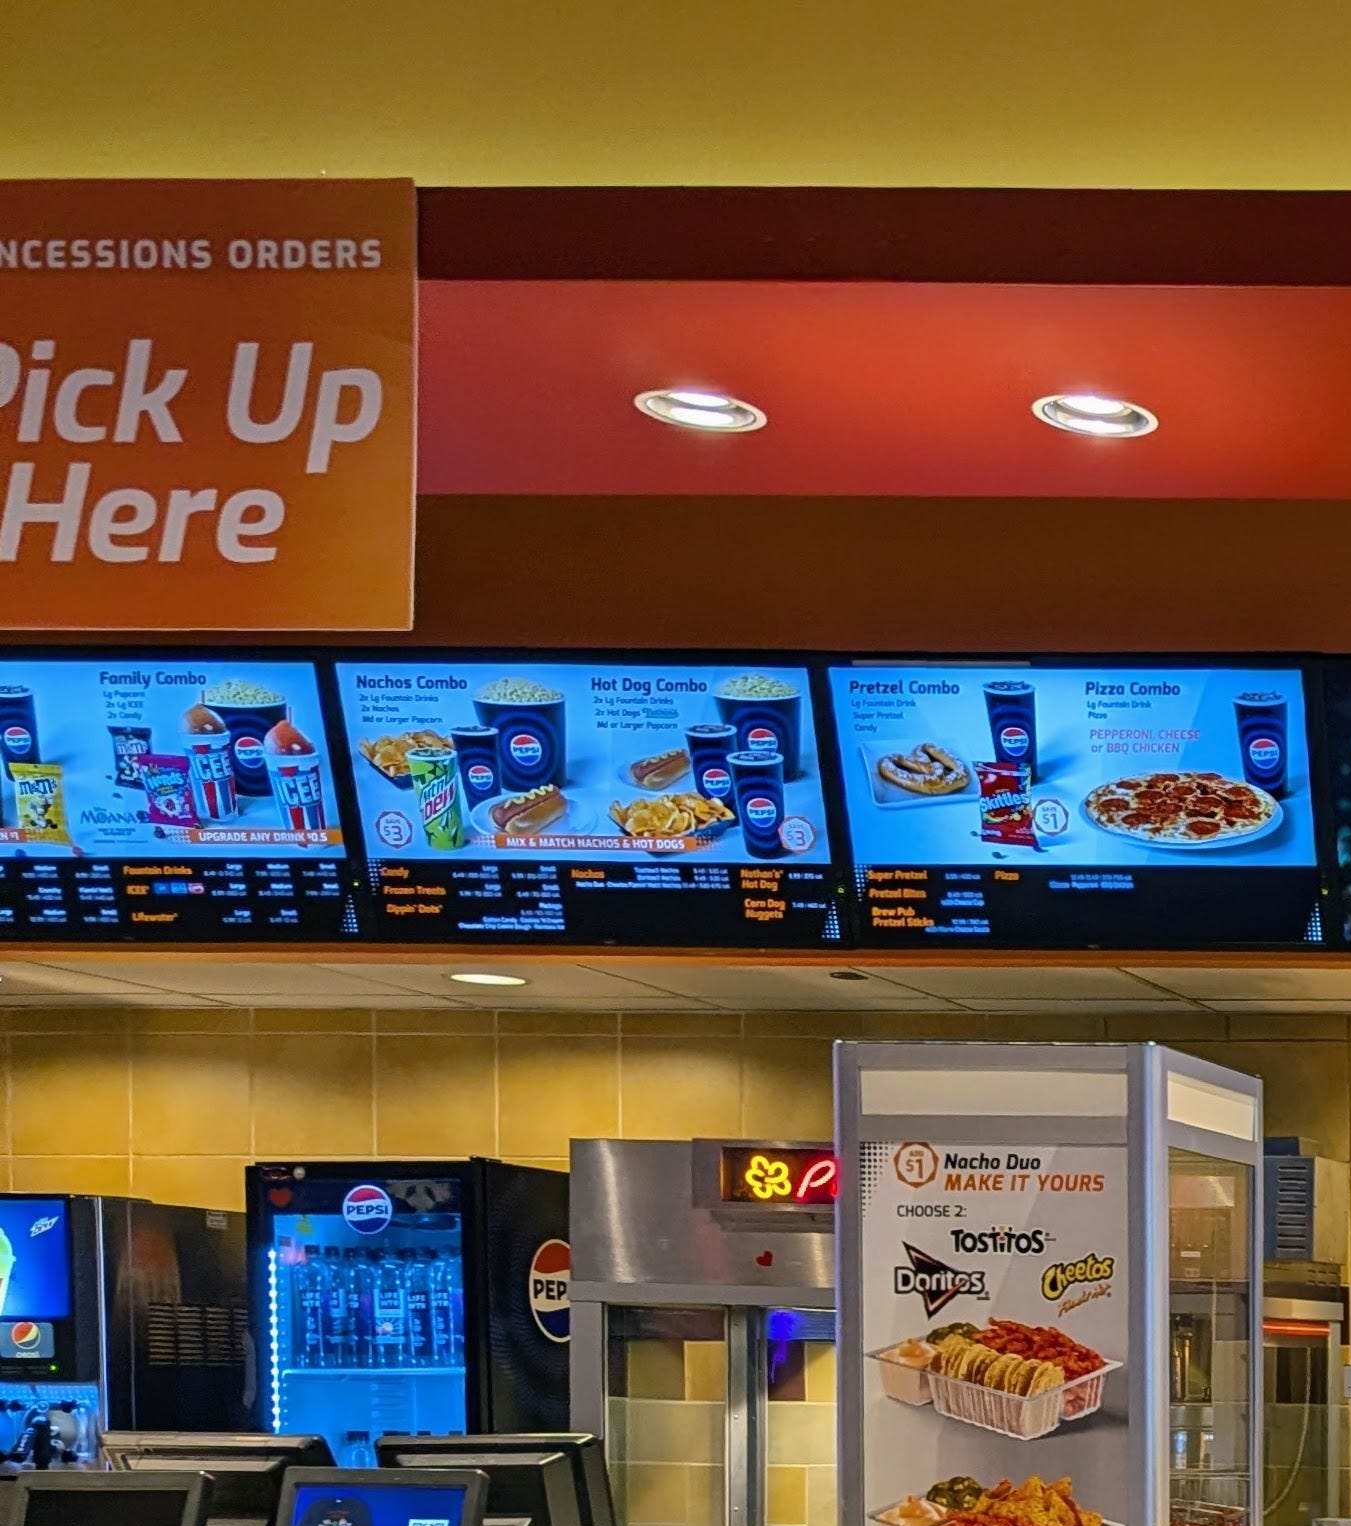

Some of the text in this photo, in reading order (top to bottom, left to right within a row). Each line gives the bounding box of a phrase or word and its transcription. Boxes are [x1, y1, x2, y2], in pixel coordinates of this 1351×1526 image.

[228, 239, 381, 269] ORDERS
[227, 342, 382, 474] Up
[0, 463, 285, 562] Here
[100, 671, 206, 689] Family Combo
[356, 675, 467, 690] Nachos Combo
[592, 677, 707, 695] Hot Dog Combo
[850, 680, 960, 695] Pretzel Combo
[1085, 682, 1181, 695] Pizza Combo
[1159, 729, 1200, 740] CHEESE
[1107, 743, 1180, 754] BBQ CHICKEN
[250, 832, 271, 842] ANY
[507, 837, 685, 849] MIX MATCH NACHOS HOT DOGS
[906, 1158, 923, 1179] $1
[944, 1153, 1041, 1170] Nacho Duo
[944, 1174, 1104, 1191] MAKE IT YOURS
[346, 1204, 389, 1215] PEPSI
[897, 1204, 967, 1217] CHOOSE 2:
[896, 1268, 984, 1294] Doritos
[1043, 1254, 1114, 1300] Cheetos
